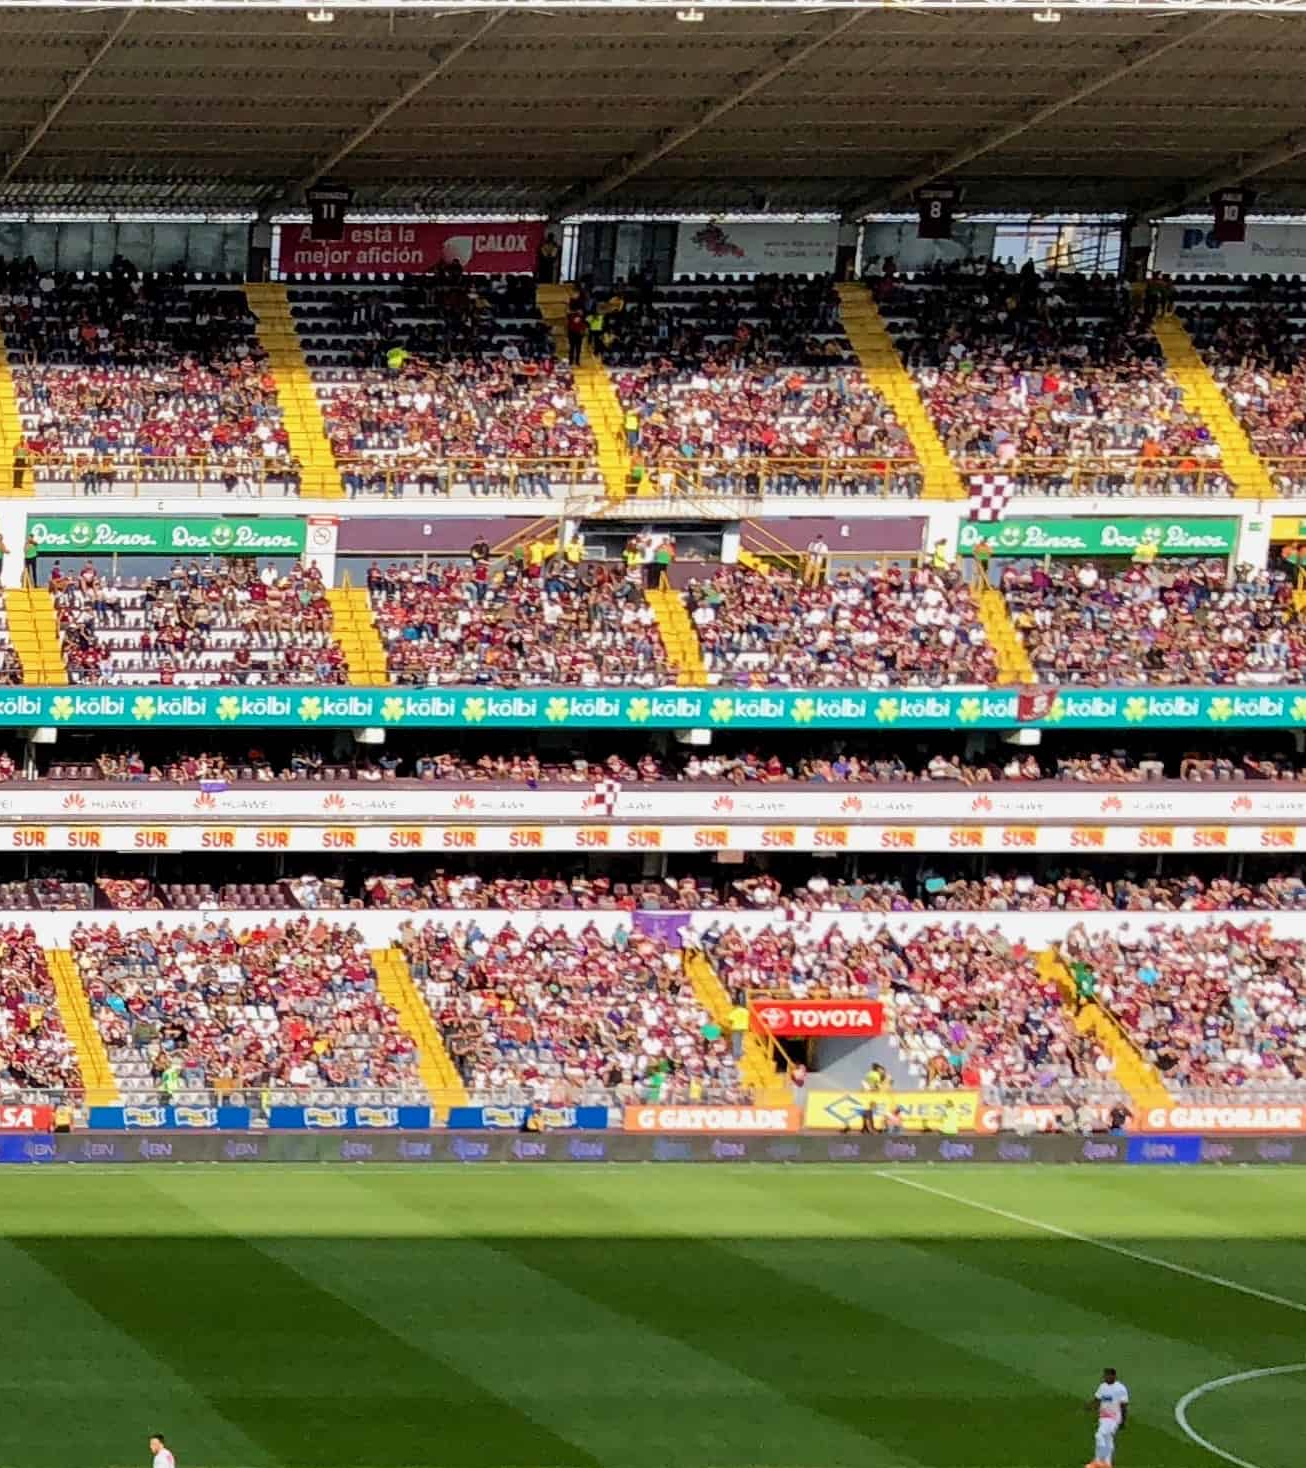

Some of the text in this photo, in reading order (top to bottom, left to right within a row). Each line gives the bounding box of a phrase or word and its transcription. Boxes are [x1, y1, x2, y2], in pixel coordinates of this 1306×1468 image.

[322, 203, 336, 219] 11
[930, 201, 942, 218] 8
[351, 227, 392, 243] está
[398, 226, 415, 243] la
[475, 235, 527, 252] CALOX
[294, 247, 423, 267] mejor afición
[32, 523, 156, 546] Dos Pinos
[172, 524, 298, 547] Dos Pinos
[1024, 526, 1087, 549] Pinos
[1101, 525, 1228, 549] Dos Pinos
[75, 695, 124, 717] kölbi
[157, 695, 206, 717] kölbi
[241, 695, 290, 717] kölbi
[323, 696, 372, 718] kölbi
[405, 696, 454, 718] kölbi
[487, 696, 536, 718] kölbi
[570, 696, 619, 718] kölbi
[651, 696, 700, 718] kölbi
[735, 696, 784, 718] kölbi
[816, 696, 865, 718] kölbi
[901, 696, 950, 718] kölbi
[1067, 697, 1116, 719] kölbi
[1149, 697, 1198, 719] kölbi
[1234, 697, 1283, 719] kölbi
[13, 831, 45, 847] SUR
[67, 831, 100, 847] SUR
[134, 831, 168, 847] SUR
[202, 831, 235, 847] SUR
[256, 831, 289, 847] SUR
[322, 831, 356, 847] SUR
[389, 831, 422, 847] SUR
[443, 831, 476, 847] SUR
[509, 830, 543, 846] SUR
[575, 830, 609, 846] SUR
[628, 830, 661, 846] SUR
[694, 830, 727, 846] SUR
[761, 830, 794, 846] SUR
[791, 1009, 873, 1028] TOYOTA
[637, 1108, 787, 1129] G GATORADE
[1148, 1108, 1302, 1129] G GATORADE
